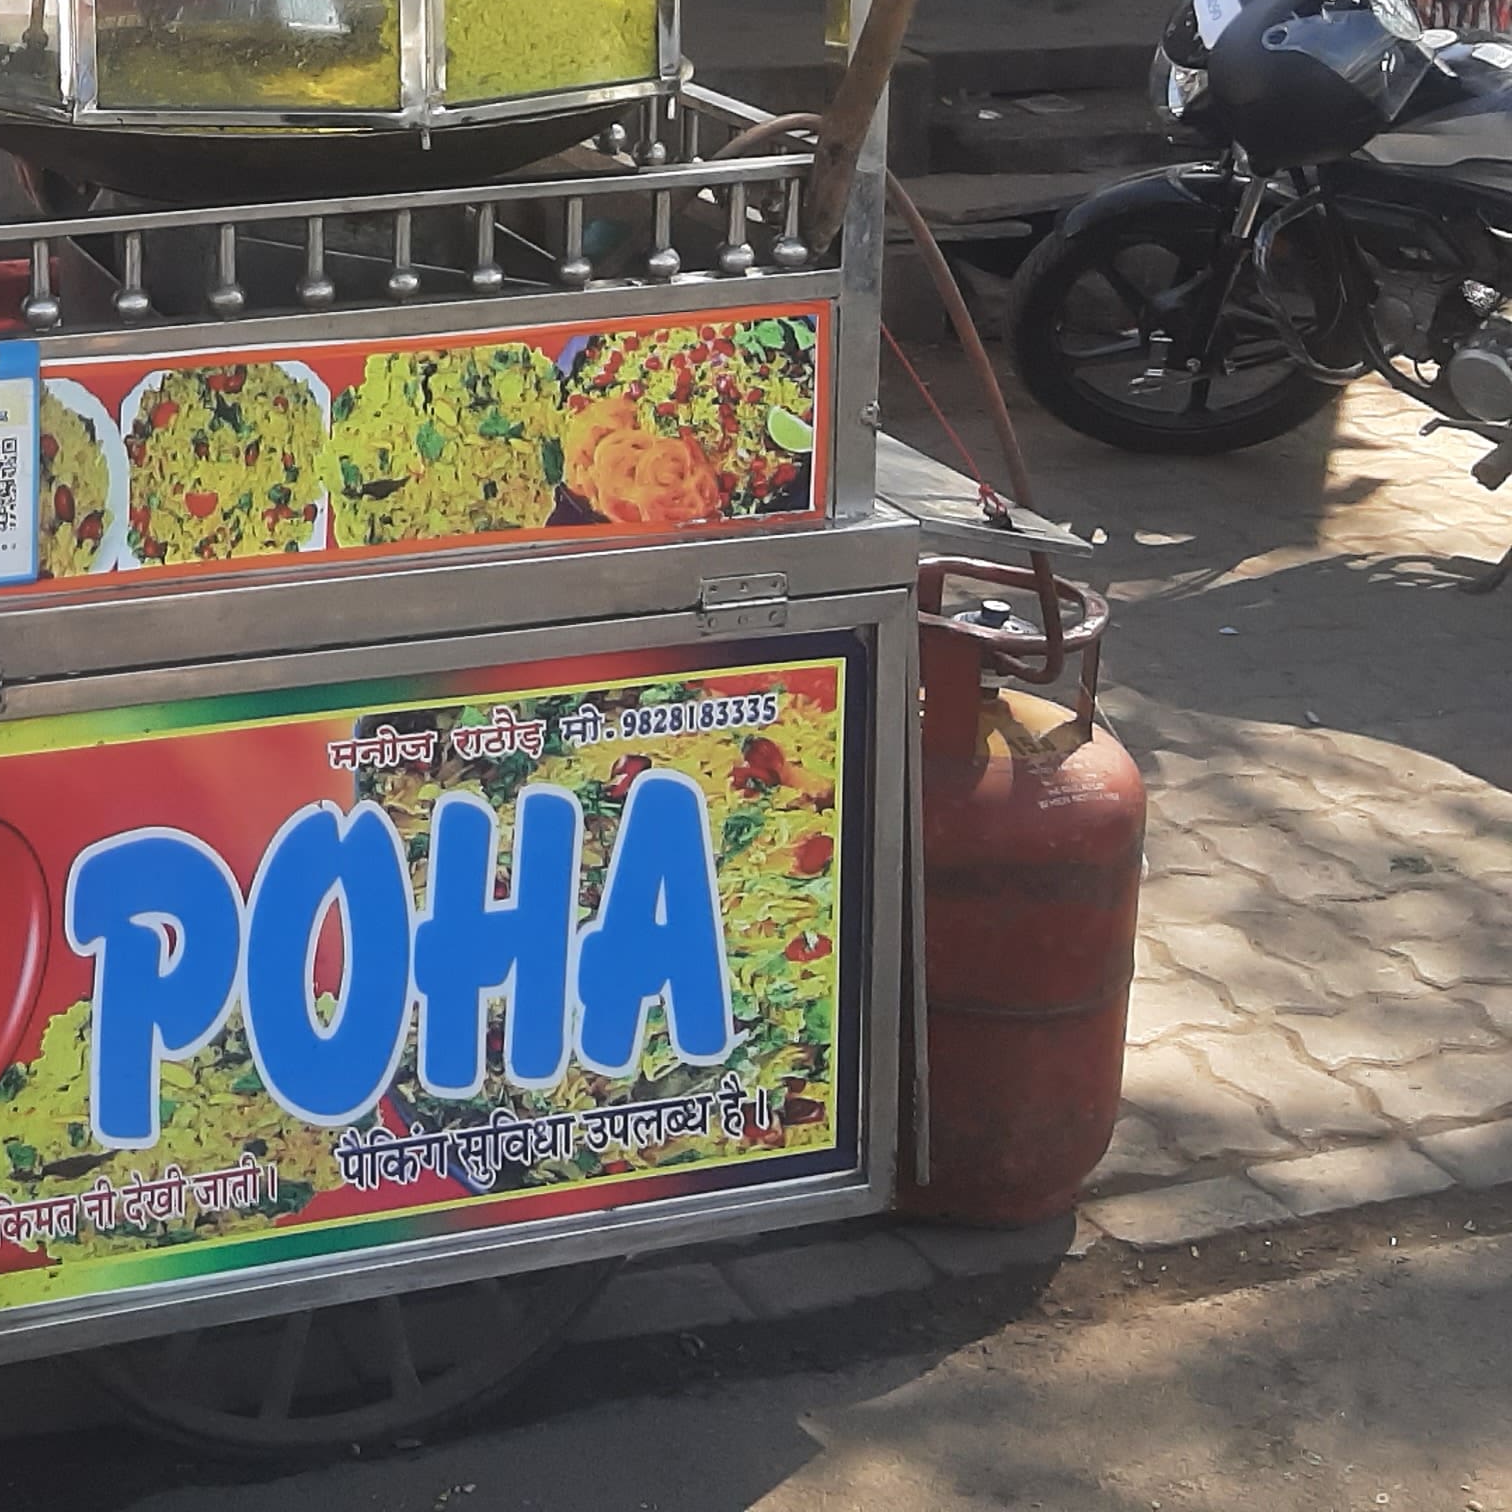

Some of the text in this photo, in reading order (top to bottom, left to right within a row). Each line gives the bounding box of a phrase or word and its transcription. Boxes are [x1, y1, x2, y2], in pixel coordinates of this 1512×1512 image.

[327, 724, 438, 771] मनोज
[66, 769, 742, 1149] POHA
[336, 1122, 450, 1190] पैकिंग
[454, 1108, 577, 1188] सुविधा
[581, 1093, 715, 1152] उपलब्ध
[121, 1162, 187, 1232] देखी
